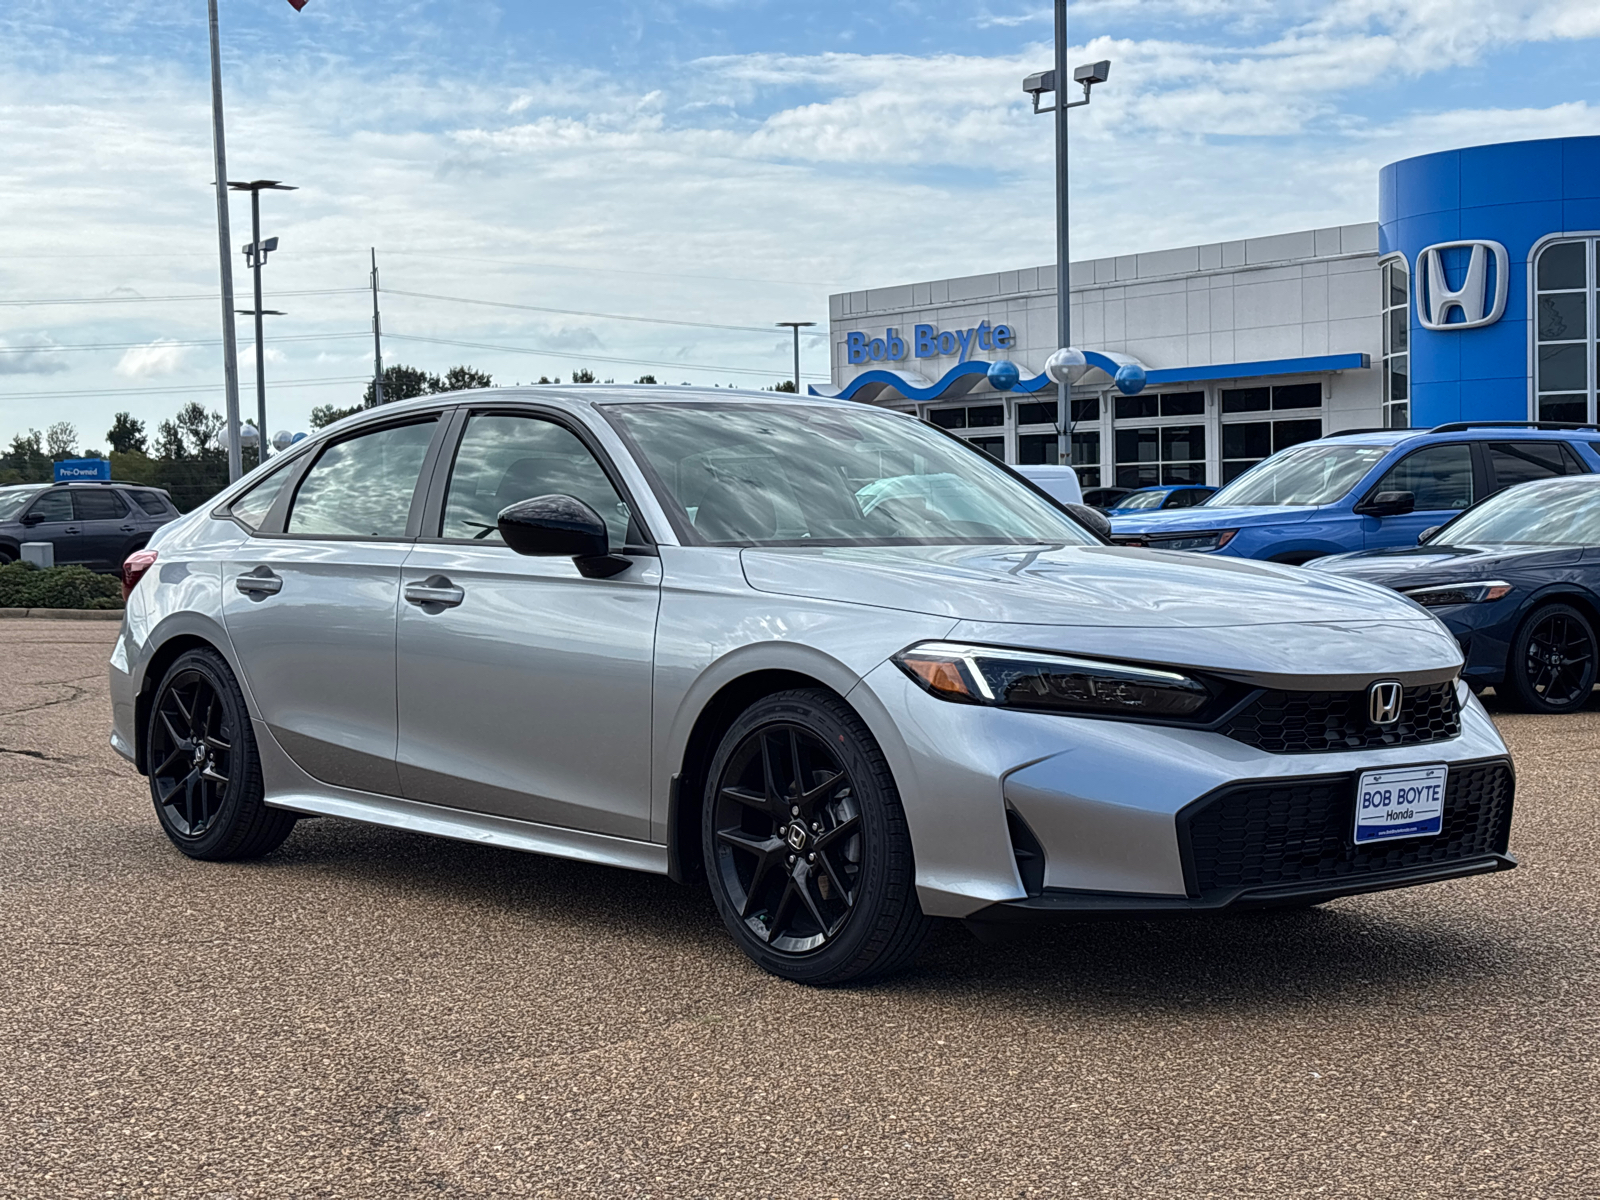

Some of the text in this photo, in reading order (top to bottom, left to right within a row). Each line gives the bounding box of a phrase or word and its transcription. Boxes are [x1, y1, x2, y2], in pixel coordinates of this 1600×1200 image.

[847, 320, 1012, 364] Bob Boyte
[60, 468, 98, 476] Pre-Owned
[1362, 784, 1441, 809] BOB BOYTE
[1385, 808, 1414, 821] Honda
